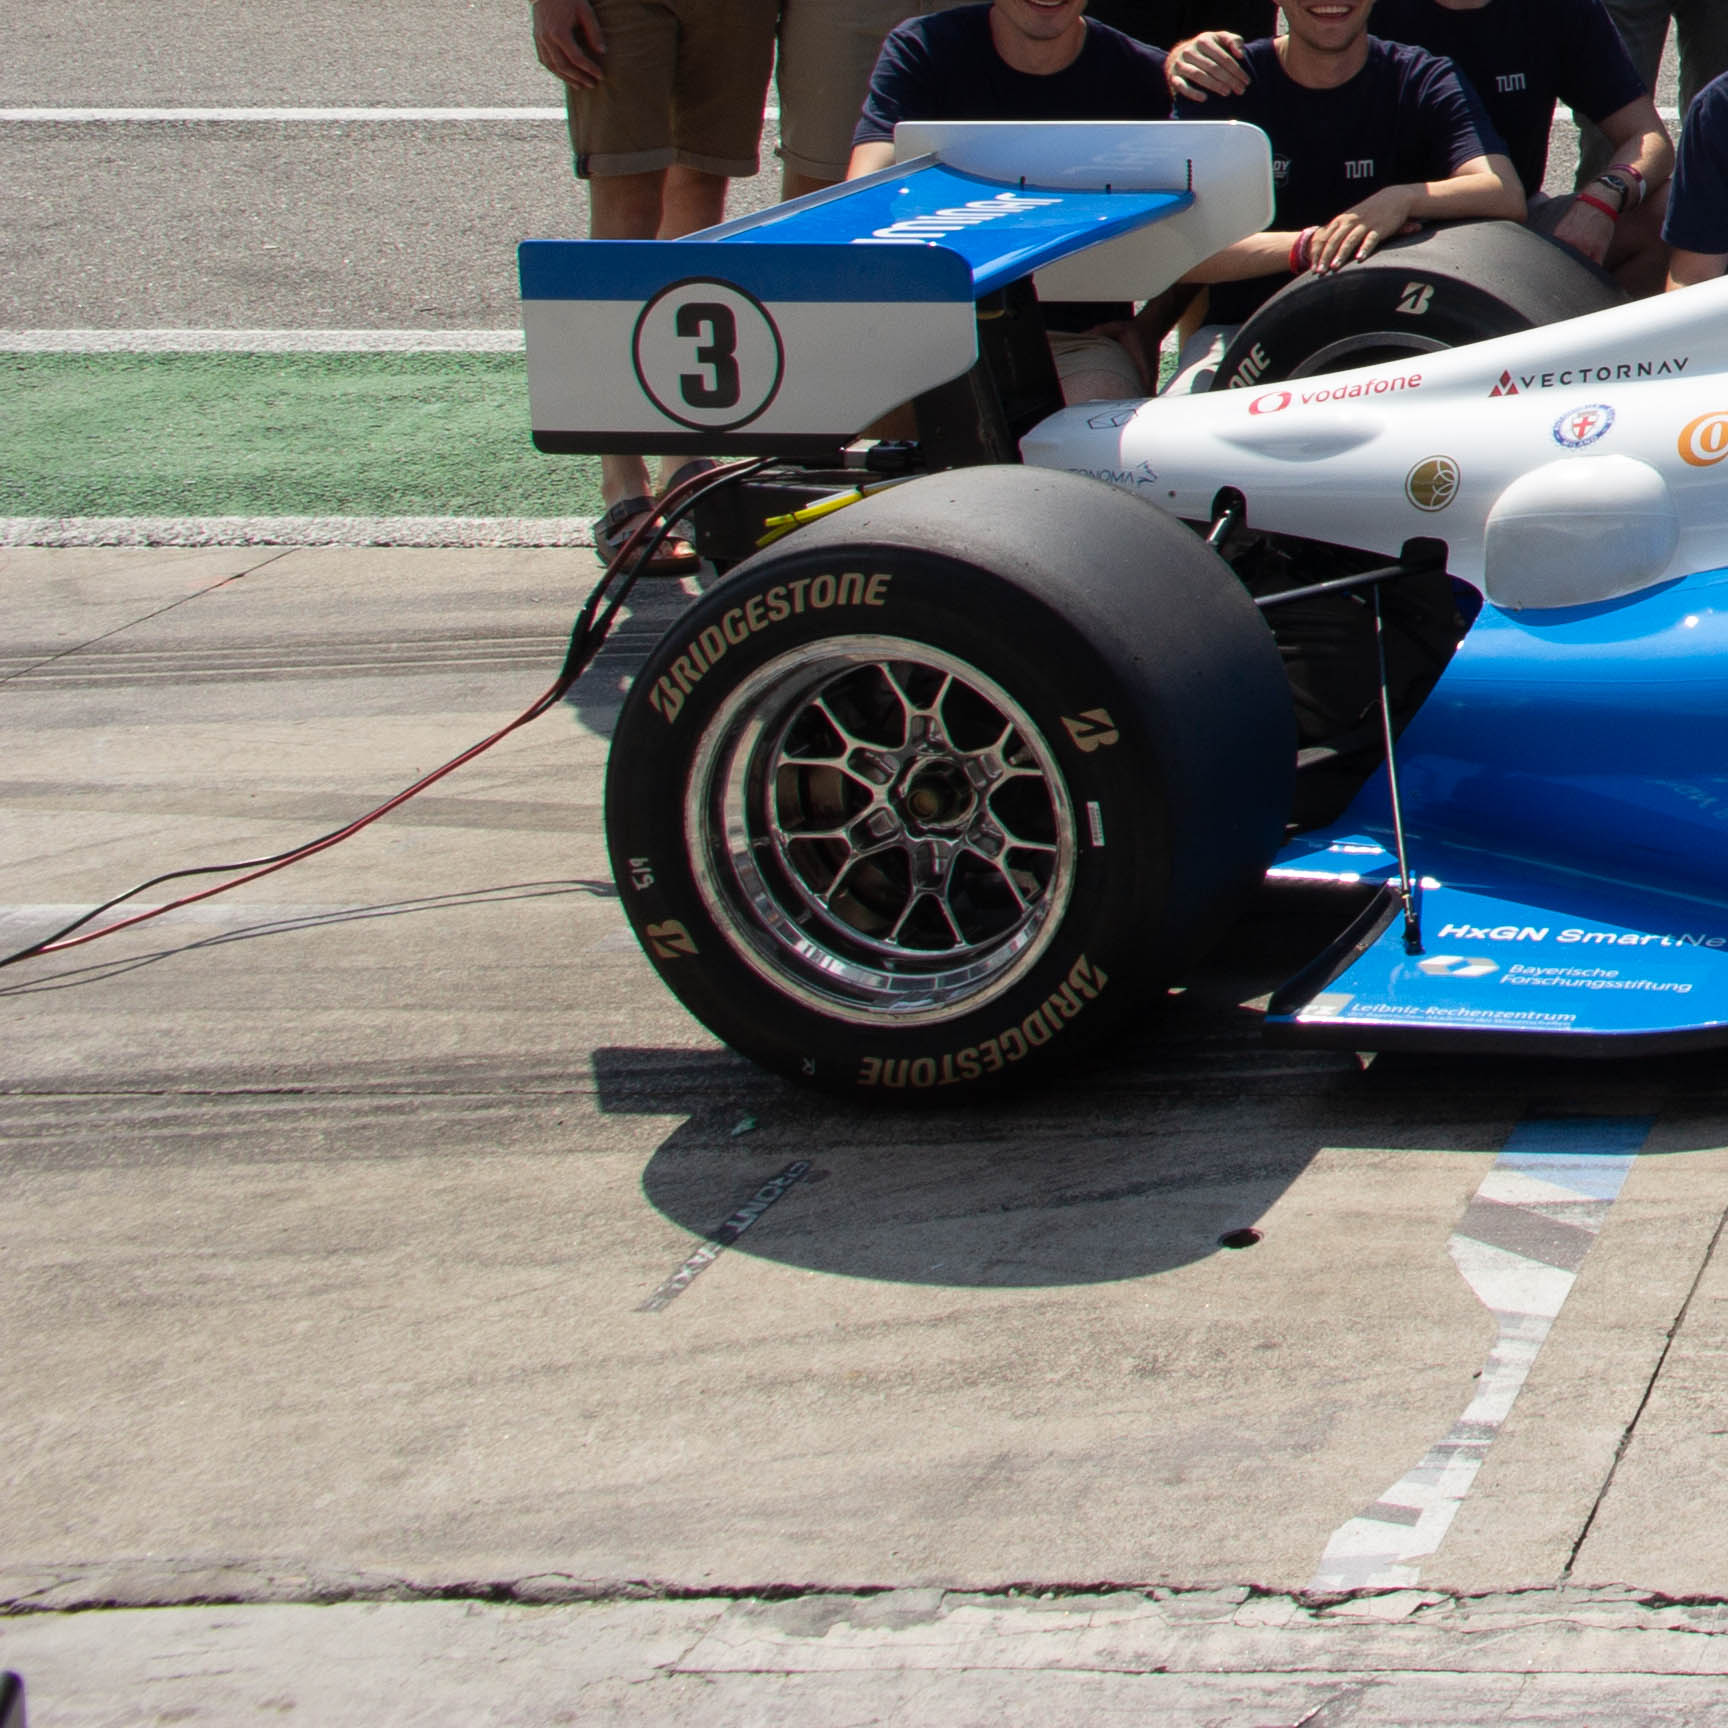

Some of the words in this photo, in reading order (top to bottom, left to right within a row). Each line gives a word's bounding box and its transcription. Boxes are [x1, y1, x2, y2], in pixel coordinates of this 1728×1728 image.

[1496, 73, 1525, 92] TUM
[1345, 160, 1374, 179] TUM
[675, 302, 738, 409] 3
[1521, 357, 1689, 389] VECTORNAV
[1301, 373, 1422, 405] vodafone
[650, 573, 892, 724] BRIDGESTONE
[1437, 923, 1548, 944] HxGN
[1509, 963, 1620, 978] Bayerische
[1500, 975, 1694, 993] Forschungsstiftung
[857, 954, 1109, 1089] BRIDGESTONE
[1351, 1002, 1577, 1023] Leibniz-Rechenzentrum
